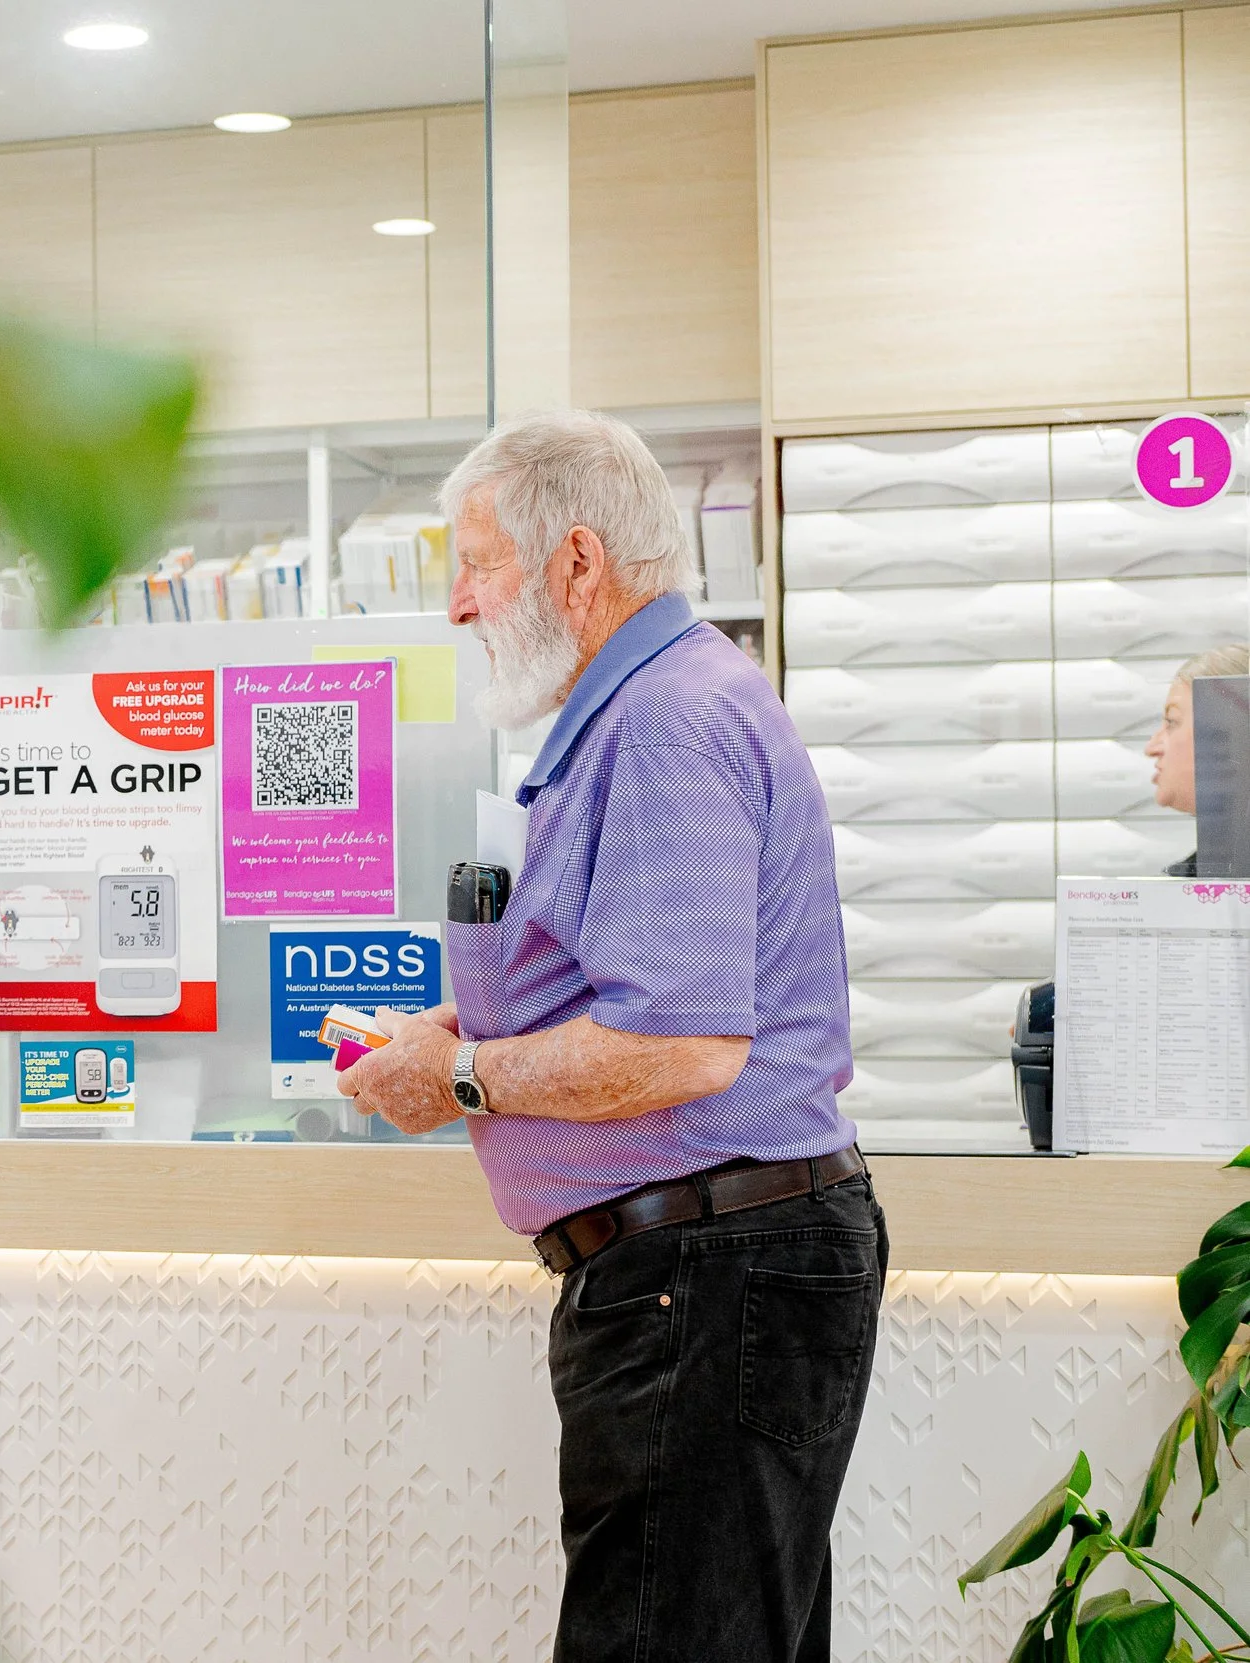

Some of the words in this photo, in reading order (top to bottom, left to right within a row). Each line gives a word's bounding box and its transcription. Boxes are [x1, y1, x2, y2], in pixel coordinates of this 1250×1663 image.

[1168, 436, 1204, 488] 1
[126, 681, 145, 691] Ask
[148, 683, 160, 691] us
[163, 681, 178, 691] for
[180, 682, 204, 693] your
[234, 674, 271, 695] How
[278, 672, 314, 692] did
[321, 680, 344, 691] we
[350, 670, 386, 691] do?
[113, 696, 142, 707] FREE
[145, 694, 204, 707] UPGRADE
[129, 711, 160, 721] blood
[163, 710, 204, 723] glucose
[141, 727, 171, 735] meter
[174, 725, 204, 738] today
[18, 742, 62, 761] time
[70, 742, 92, 760] to
[70, 765, 98, 794] A
[111, 763, 202, 793] GRIP
[1, 809, 17, 818] you
[20, 807, 37, 815] find
[39, 808, 59, 818] your
[62, 806, 89, 815] blood
[92, 806, 127, 817] glucose
[130, 805, 155, 816] strips
[157, 805, 173, 813] too
[176, 804, 202, 815] flimsy
[4, 819, 25, 828] hard
[27, 820, 36, 828] to
[39, 818, 73, 828] handle?
[77, 818, 91, 828] It's
[94, 818, 113, 827] time
[115, 819, 126, 827] to
[129, 817, 171, 830] upgrade.
[232, 835, 247, 847] We
[250, 833, 292, 846] welcome
[295, 836, 318, 852] your
[323, 831, 375, 848] feedback
[377, 833, 389, 843] to
[239, 857, 278, 869] improve
[282, 855, 298, 864] our
[302, 853, 341, 864] services
[343, 853, 353, 863] to
[358, 855, 381, 870] you.
[226, 890, 254, 899] Bendigo
[264, 890, 277, 898] UFS
[284, 890, 312, 899] Bendigo
[322, 890, 335, 898] UFS
[342, 890, 370, 898] Bendigo
[380, 889, 393, 897] UFS
[1068, 890, 1106, 900] Bendigo
[1121, 891, 1138, 900] UFS
[131, 890, 159, 918] 5.8
[286, 984, 318, 992] National
[320, 984, 354, 992] Diabetes
[357, 983, 390, 991] Services
[392, 983, 425, 991] Scheme
[287, 1004, 298, 1012] An
[300, 1004, 333, 1012] Australia
[392, 1004, 425, 1012] Initiative
